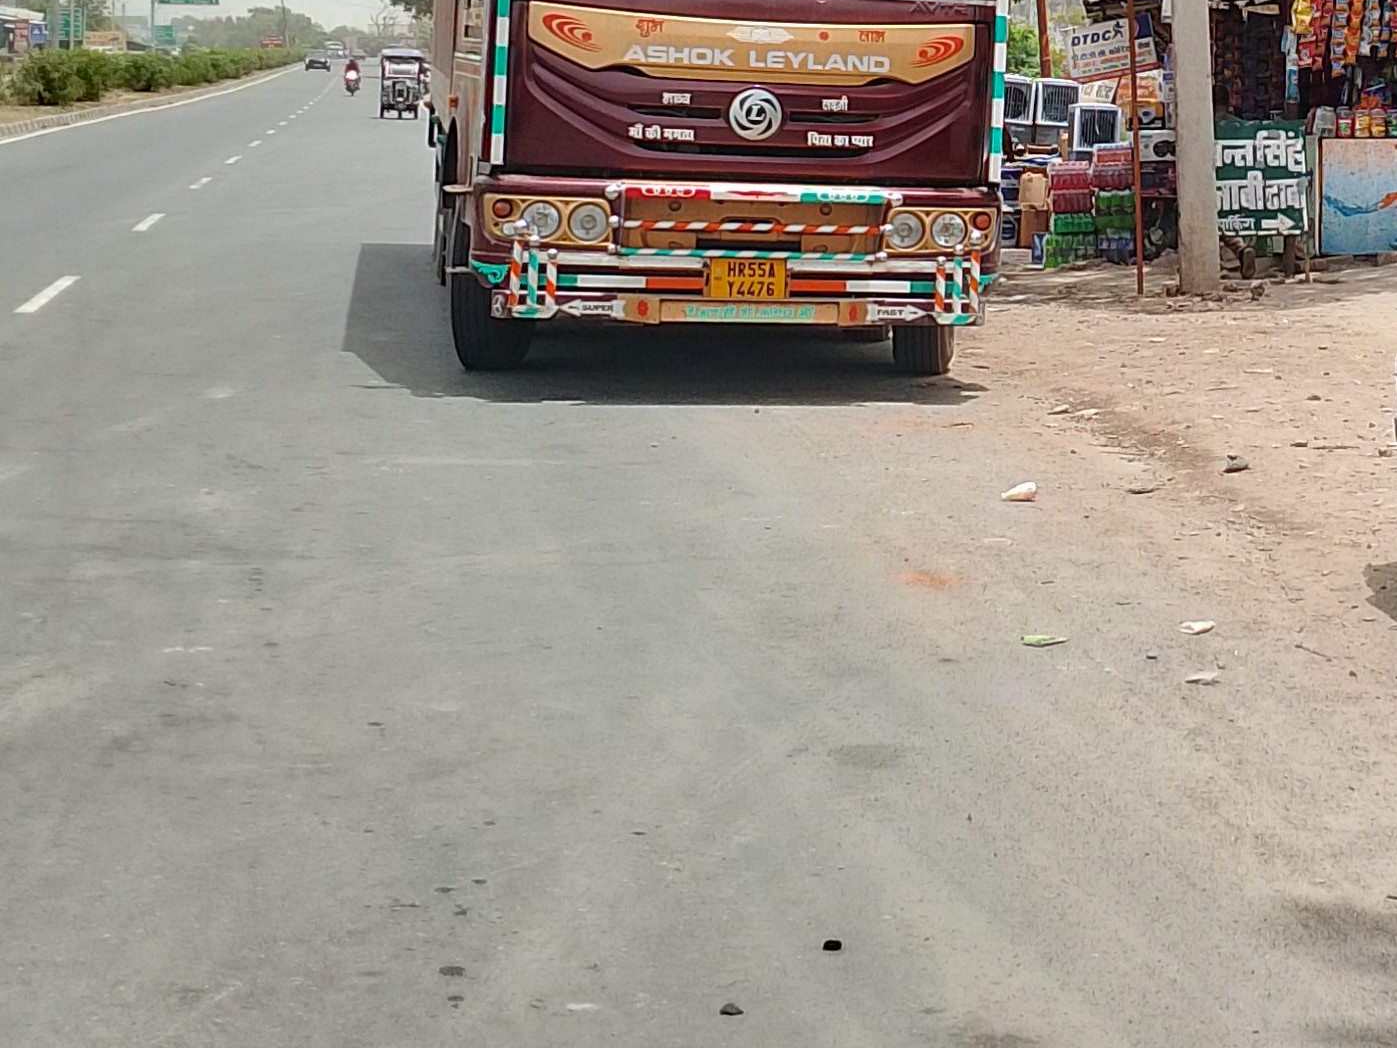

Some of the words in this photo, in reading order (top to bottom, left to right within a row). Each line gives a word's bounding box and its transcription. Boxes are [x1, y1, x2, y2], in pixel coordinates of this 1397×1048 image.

[635, 18, 665, 37] शुभ
[859, 29, 886, 43] लाभ
[1071, 29, 1113, 47] DTDC
[622, 44, 735, 67] ASHOK
[749, 49, 891, 73] LEYLAND
[727, 261, 776, 278] HR55A
[727, 280, 776, 298] Y4476
[581, 304, 614, 313] SUPER
[877, 308, 905, 316] FAST
